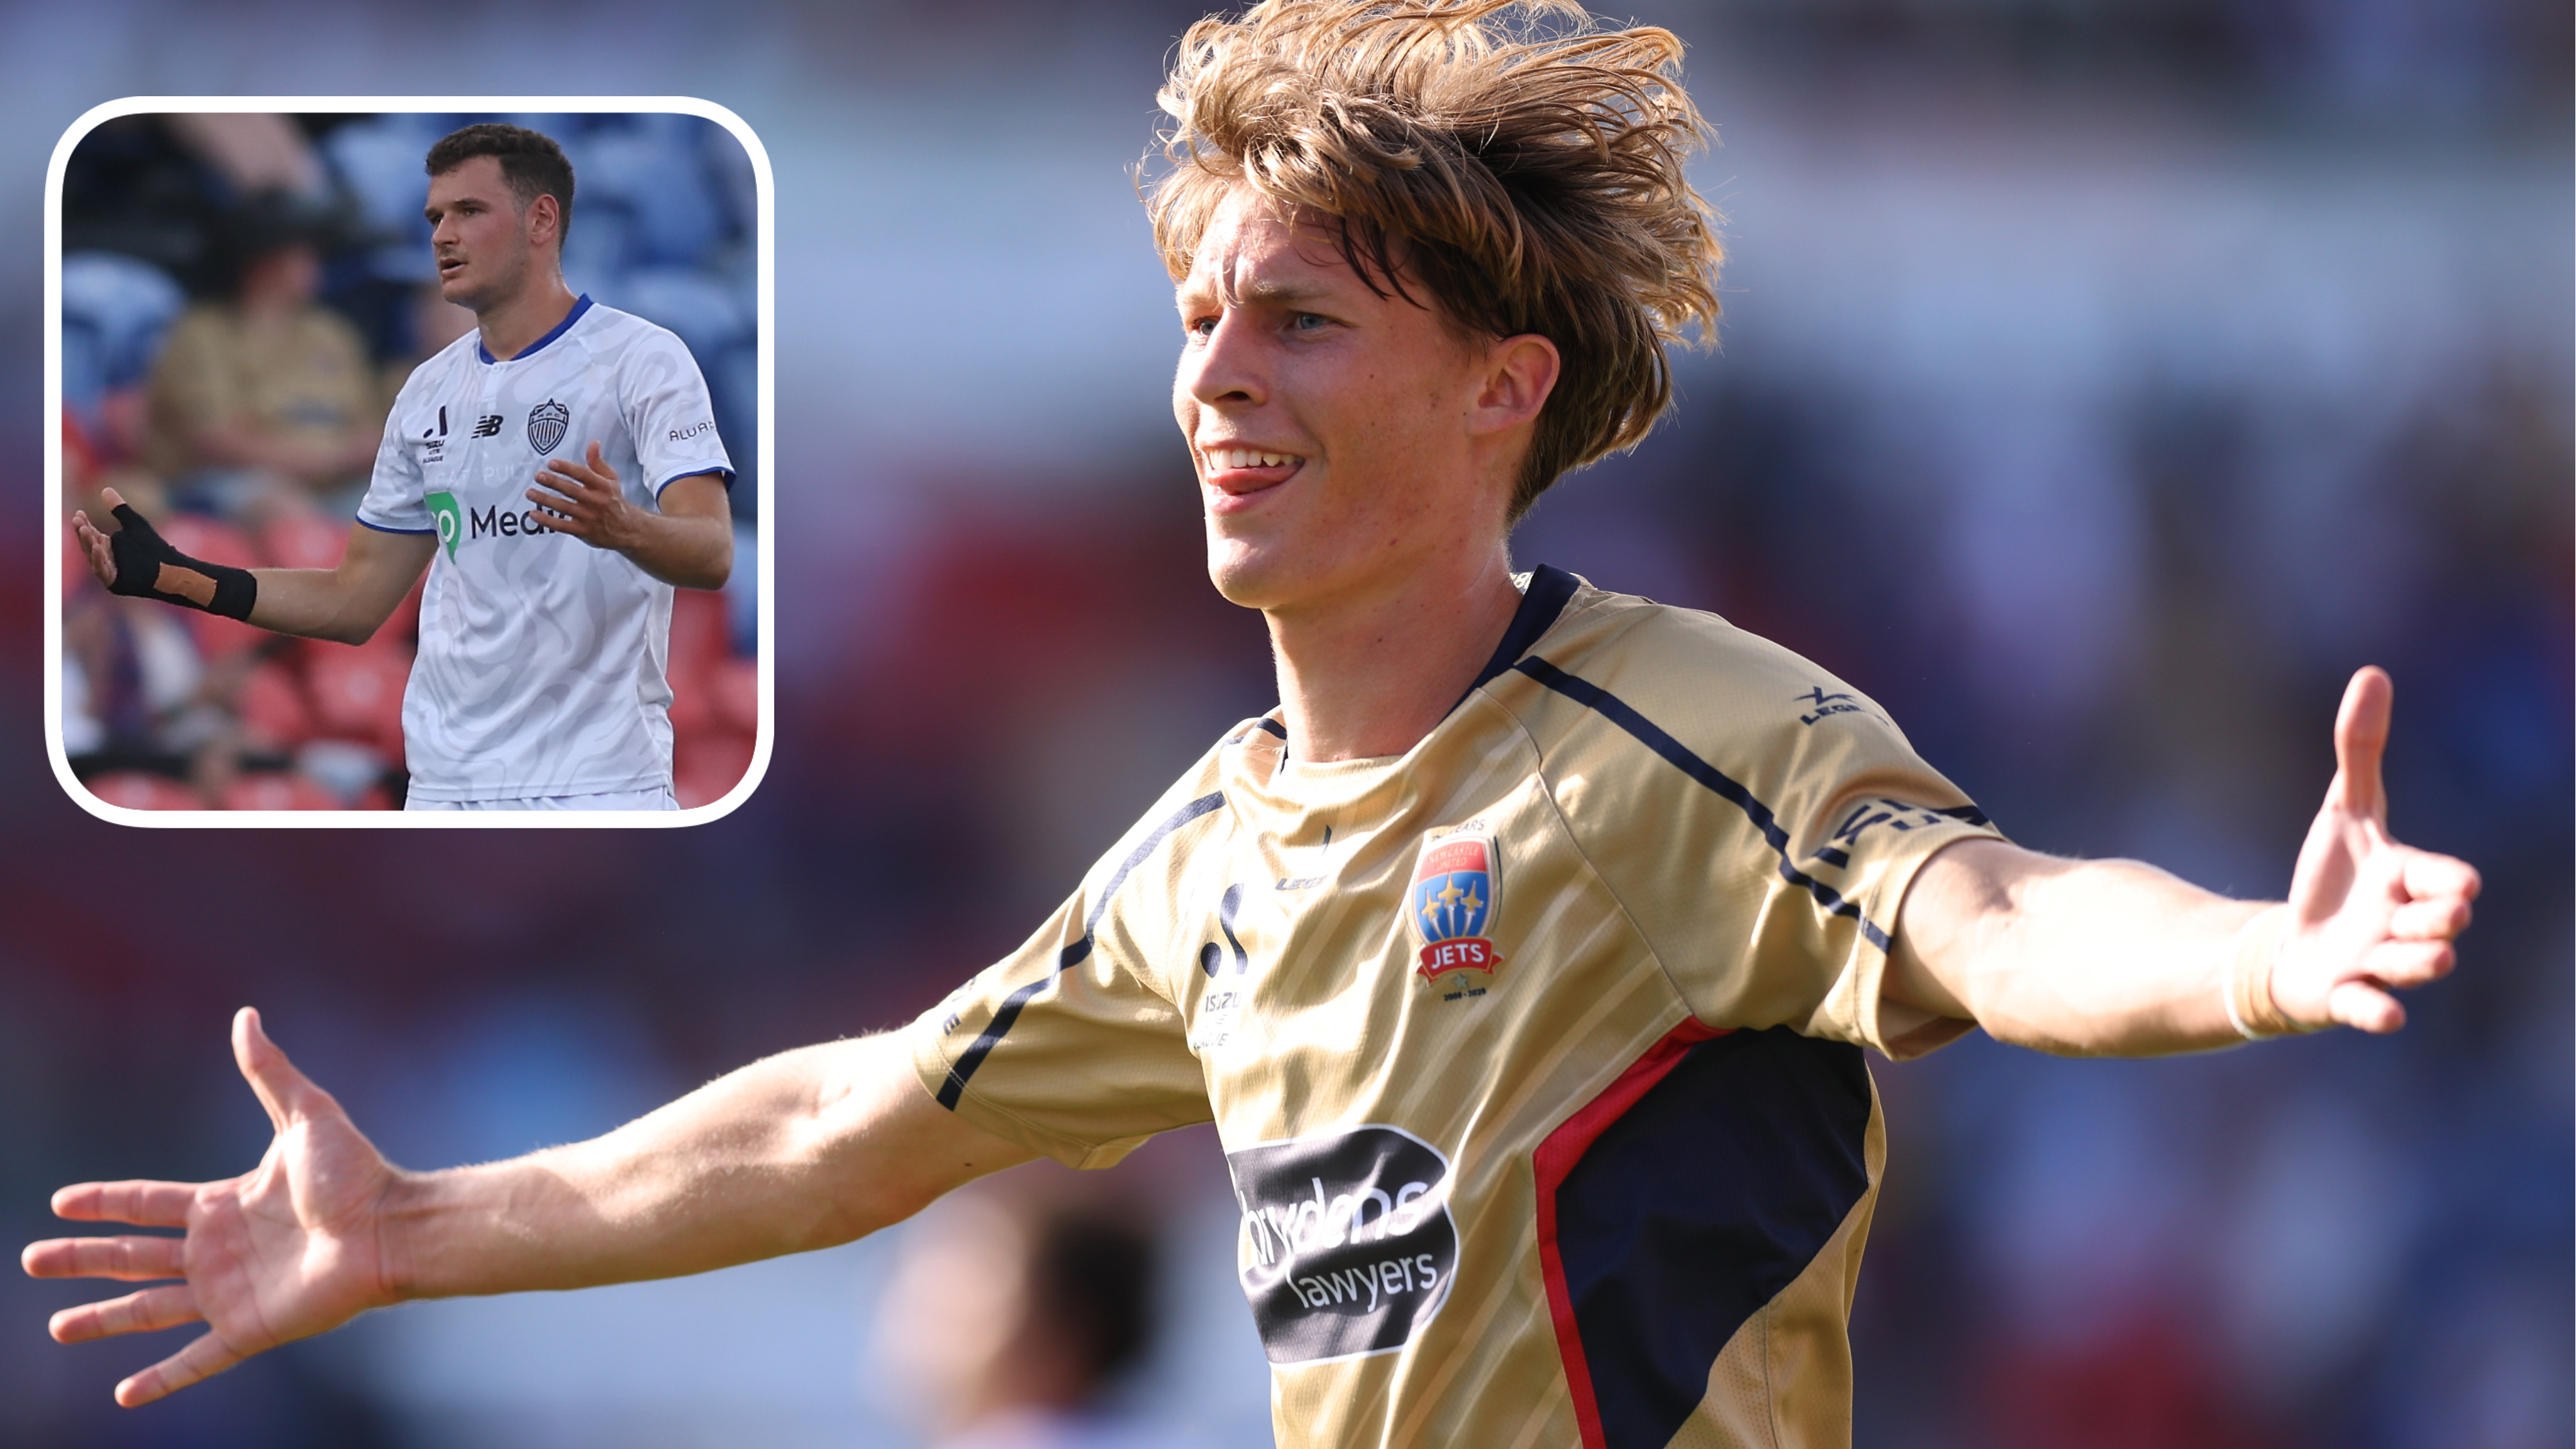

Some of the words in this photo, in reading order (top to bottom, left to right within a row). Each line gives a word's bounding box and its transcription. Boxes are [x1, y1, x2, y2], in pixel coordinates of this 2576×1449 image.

[1431, 943, 1485, 969] JETS
[1205, 992, 1241, 1013] ISUZU
[1240, 1177, 1429, 1266] brydens
[1285, 1253, 1438, 1313] lawyers
